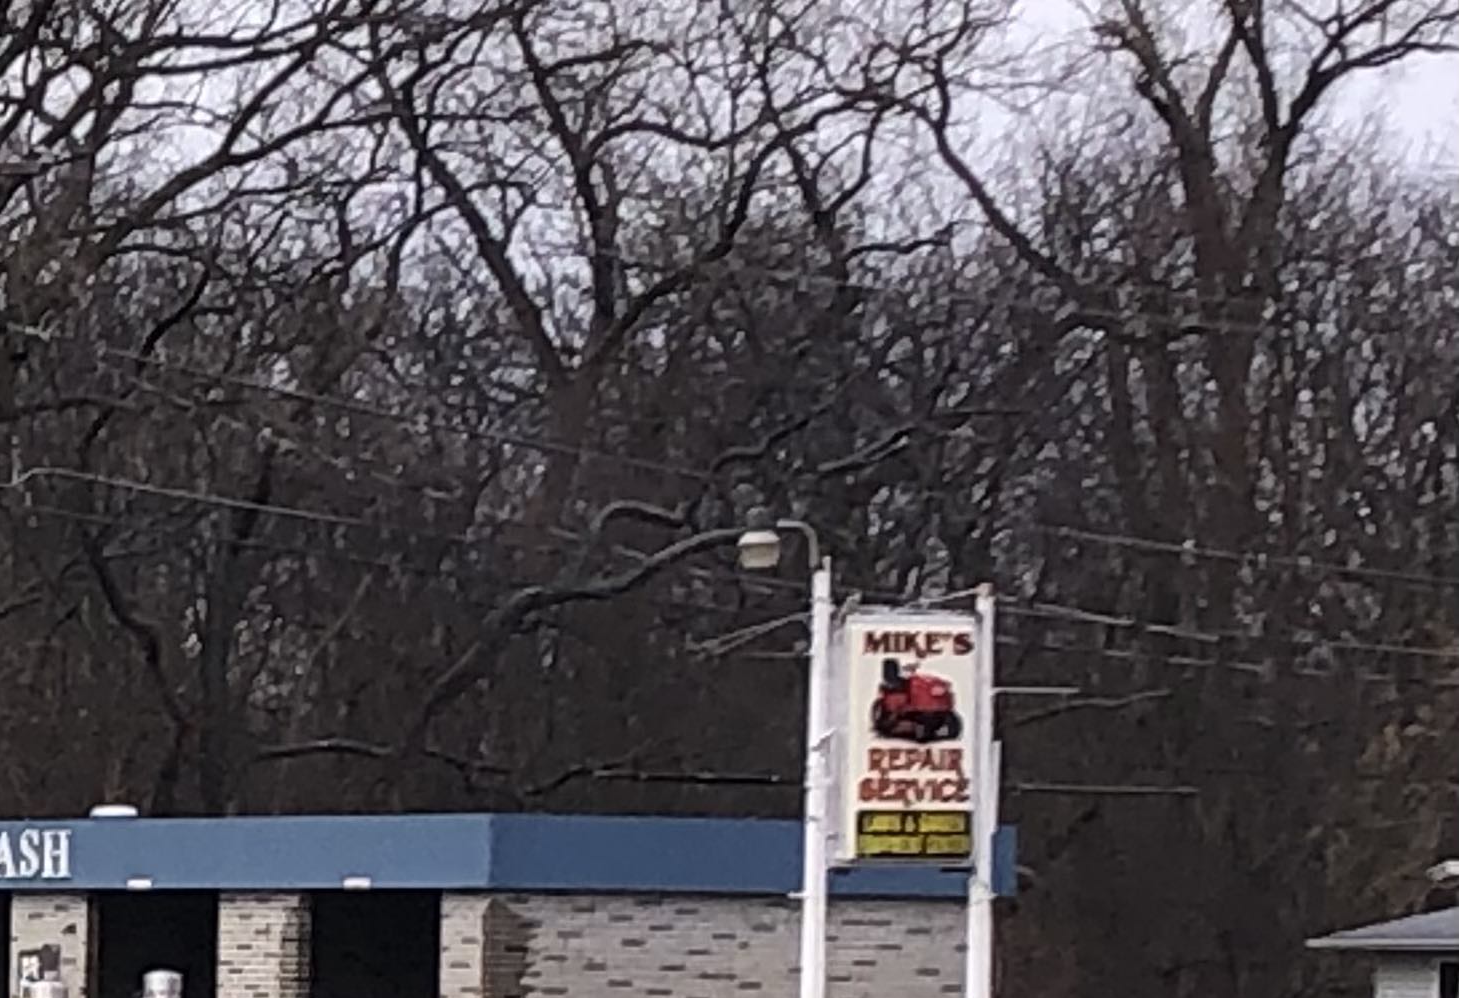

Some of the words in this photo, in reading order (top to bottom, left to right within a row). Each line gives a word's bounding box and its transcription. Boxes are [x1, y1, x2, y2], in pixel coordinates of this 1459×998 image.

[862, 631, 974, 657] MIKE'S
[868, 748, 965, 773] REPAIR
[859, 778, 970, 803] SERVICE
